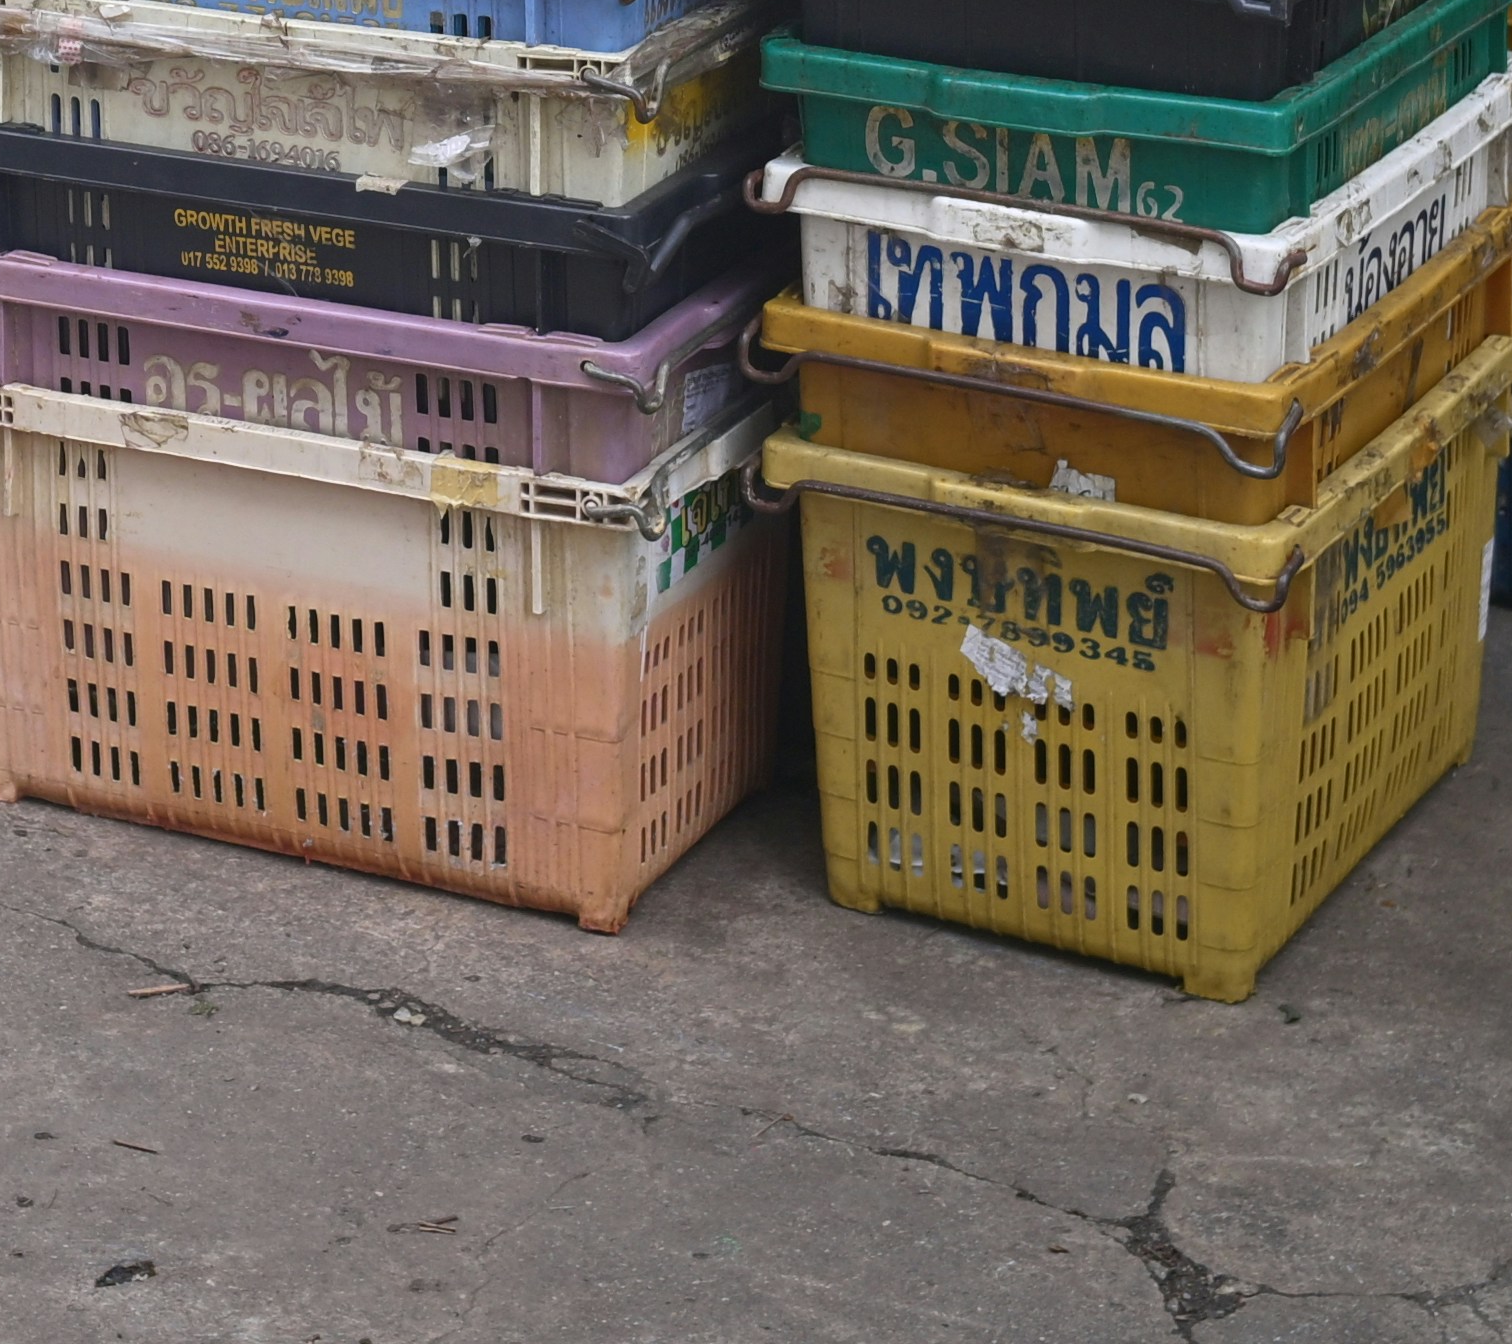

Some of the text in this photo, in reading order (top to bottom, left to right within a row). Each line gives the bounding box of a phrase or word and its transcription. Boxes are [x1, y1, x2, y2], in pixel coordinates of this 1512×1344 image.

[190, 129, 343, 174] 086-1694016
[864, 106, 1132, 210] G.SIAM
[174, 208, 357, 249] GROWTH FRESH VEGE
[214, 234, 317, 264] ENTERPRISE
[181, 249, 203, 267] 017
[205, 253, 228, 271] 552
[230, 256, 259, 276] 9398
[275, 263, 297, 282] 013
[299, 265, 322, 284] 778
[324, 268, 355, 289] 9398
[867, 230, 1187, 373] เทพกมล
